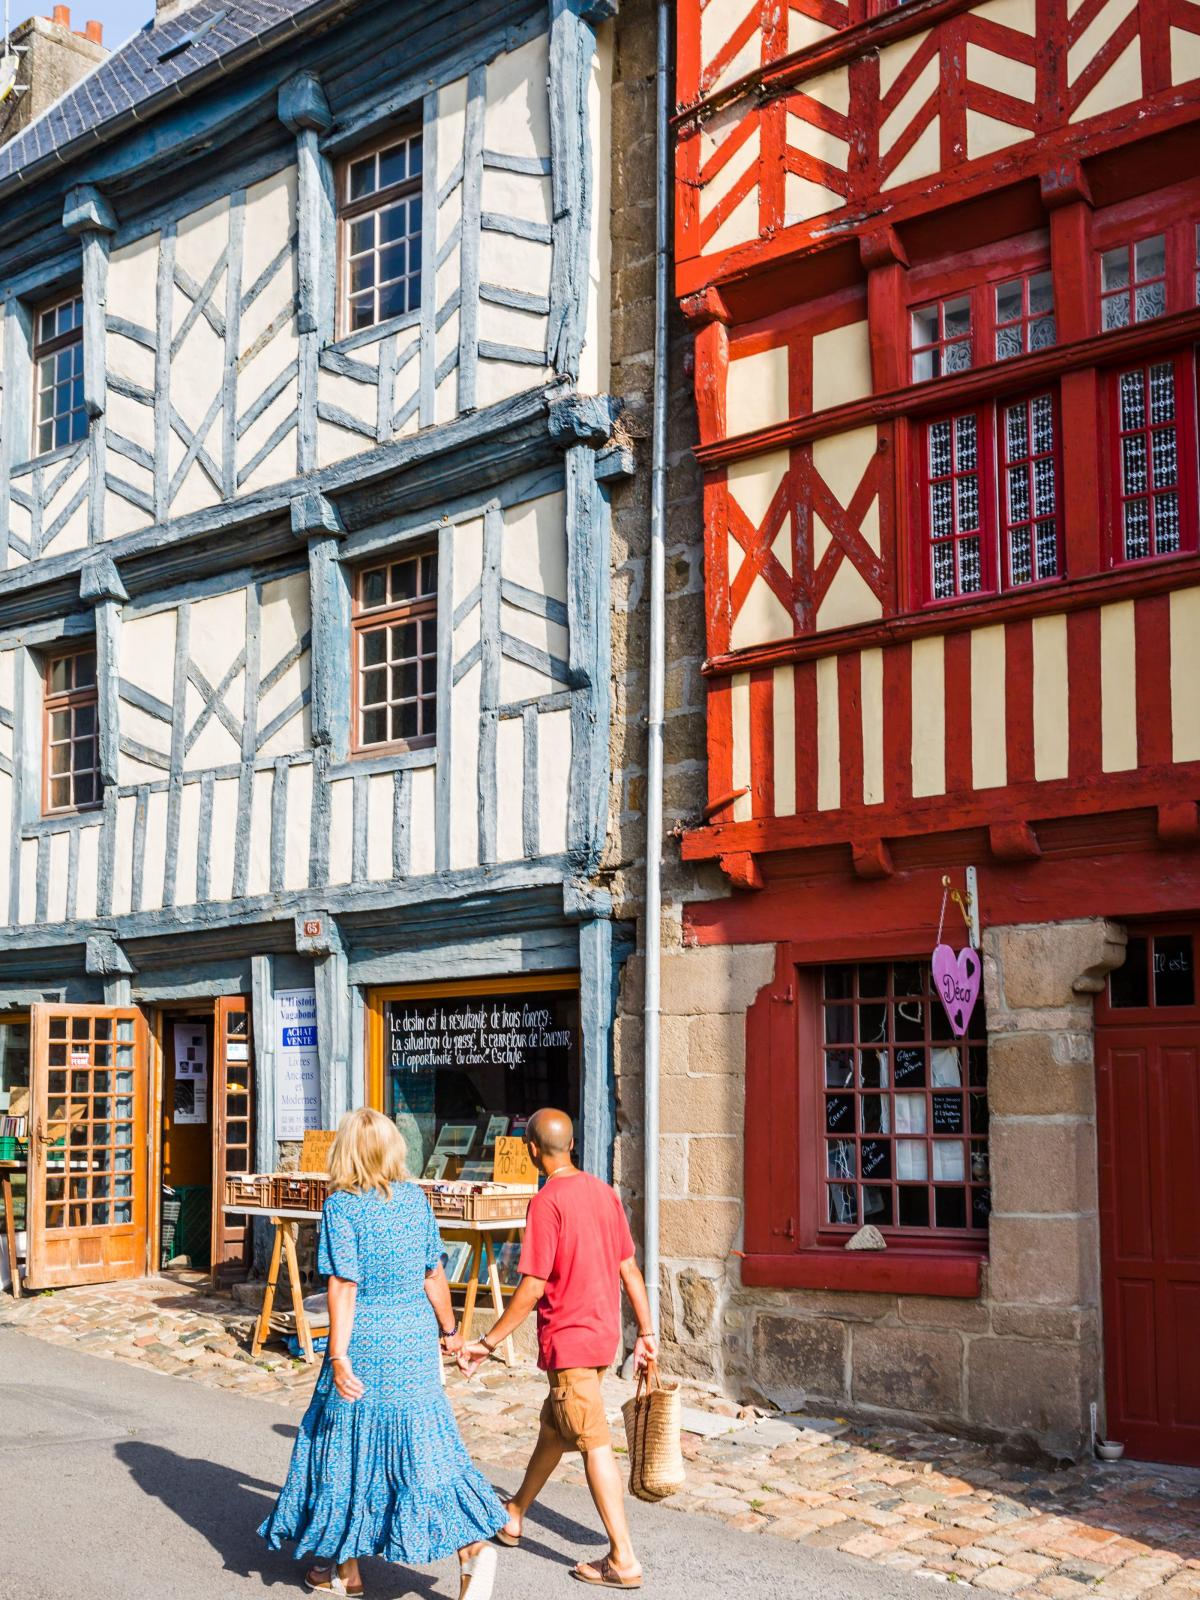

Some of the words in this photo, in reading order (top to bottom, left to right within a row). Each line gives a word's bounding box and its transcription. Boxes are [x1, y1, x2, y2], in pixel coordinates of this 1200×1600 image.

[307, 923, 318, 934] 65
[943, 974, 971, 1004] Déco
[281, 996, 316, 1007] L'Histoir
[281, 1009, 316, 1020] Vagabond
[403, 1009, 424, 1031] destin
[427, 1008, 438, 1030] est
[440, 1007, 447, 1030] la
[449, 1004, 487, 1030] résultante
[491, 1003, 500, 1028] de
[501, 1003, 520, 1028] trois
[287, 1028, 312, 1036] ACHAT
[287, 1037, 312, 1045] VENTE
[392, 1034, 402, 1051] La
[403, 1031, 440, 1051] situation
[442, 1031, 452, 1049] du
[480, 1029, 487, 1048] le
[488, 1028, 527, 1048] carrefour
[528, 1028, 538, 1047] de
[288, 1056, 311, 1066] Livres
[392, 1052, 400, 1066] Et
[402, 1049, 452, 1073] l'opportunité
[456, 1049, 465, 1065] du
[284, 1071, 315, 1080] Anciens
[295, 1083, 303, 1091] et
[281, 1094, 318, 1104] Modernes
